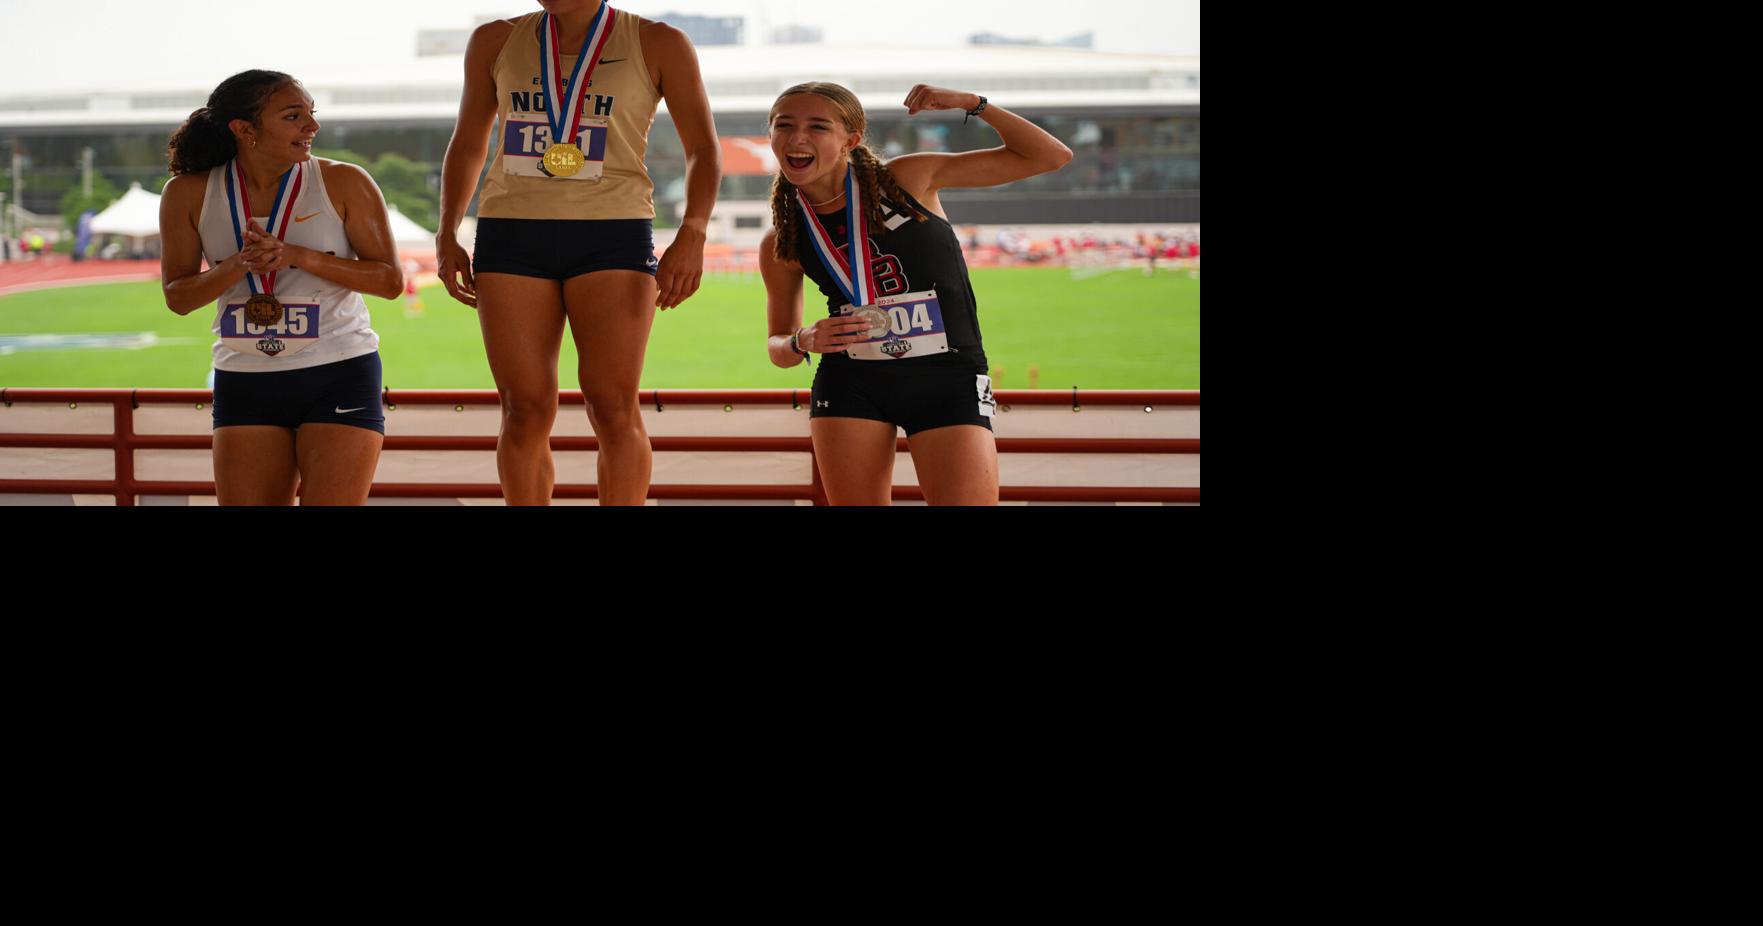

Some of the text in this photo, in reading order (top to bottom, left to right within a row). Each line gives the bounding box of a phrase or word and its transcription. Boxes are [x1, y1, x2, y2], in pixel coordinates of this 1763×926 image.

[510, 91, 614, 116] NOH
[519, 124, 592, 157] 131
[867, 303, 934, 339] 04
